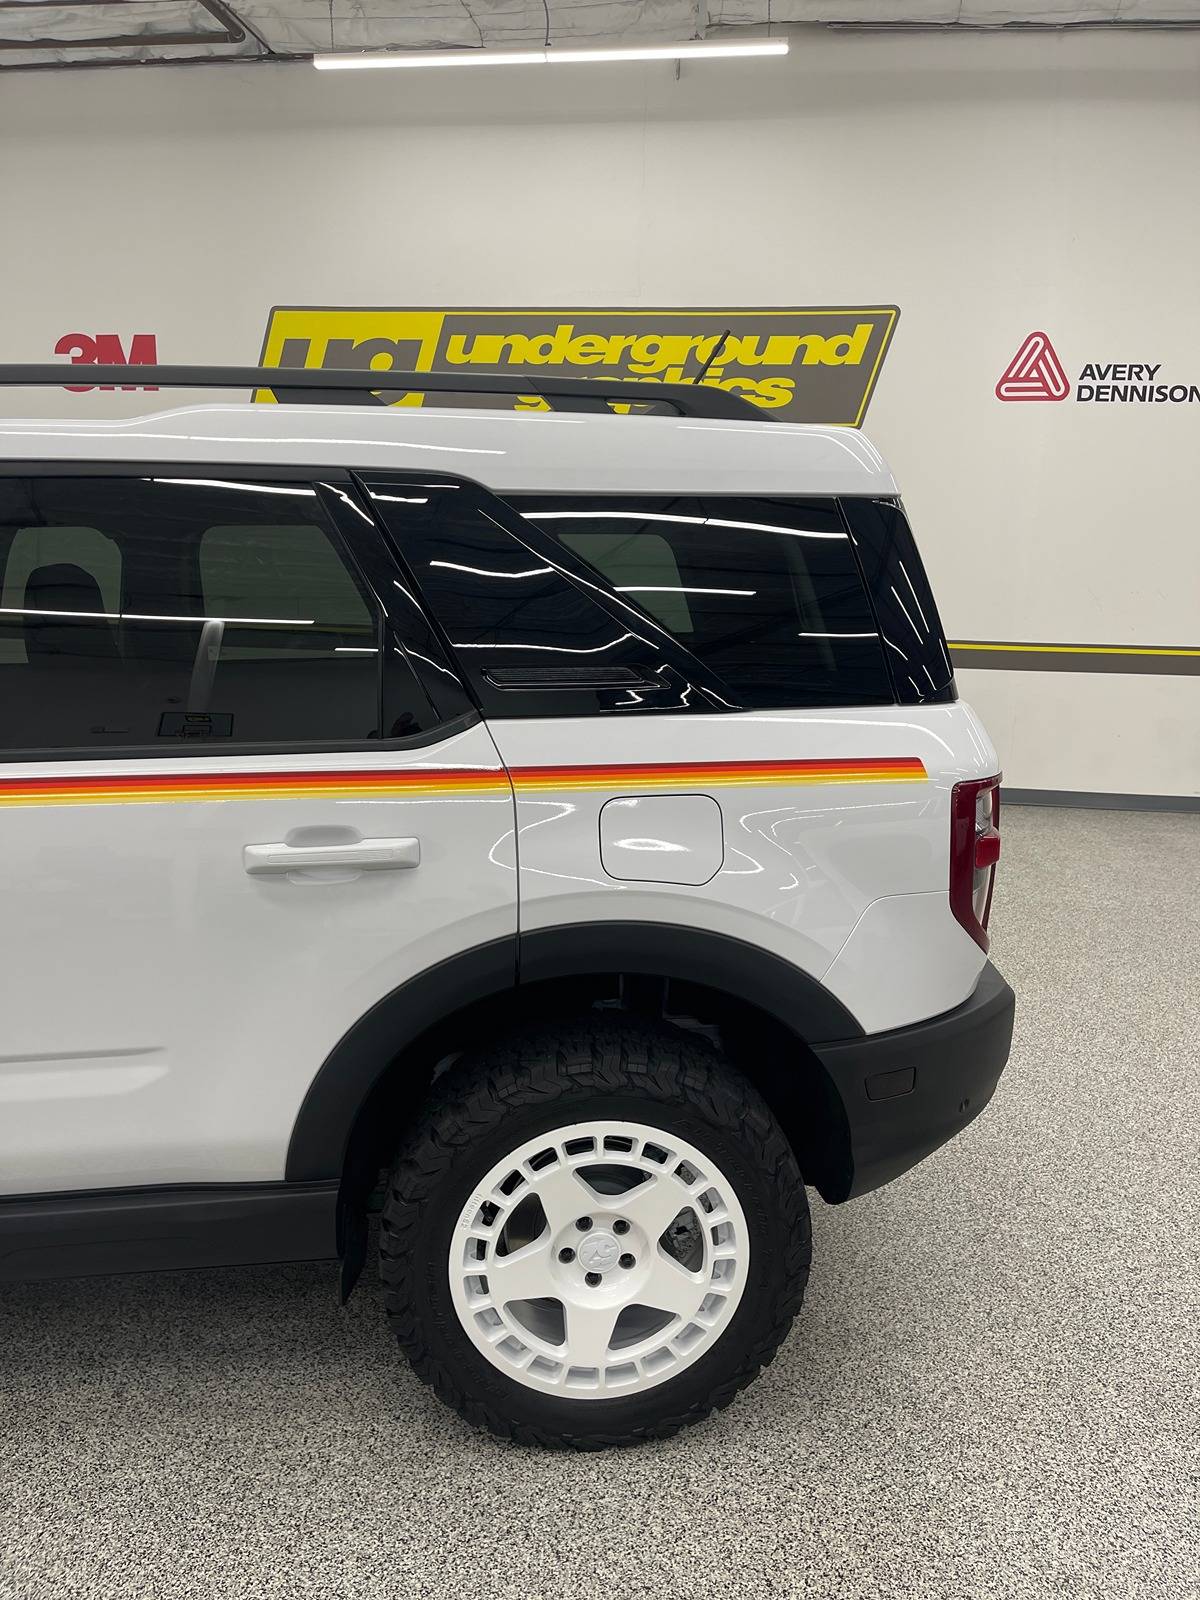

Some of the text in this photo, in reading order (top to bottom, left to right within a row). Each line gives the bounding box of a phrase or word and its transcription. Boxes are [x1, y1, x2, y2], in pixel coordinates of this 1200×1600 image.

[54, 333, 159, 392] 3M
[446, 324, 874, 374] underground
[1078, 364, 1162, 381] AVERY
